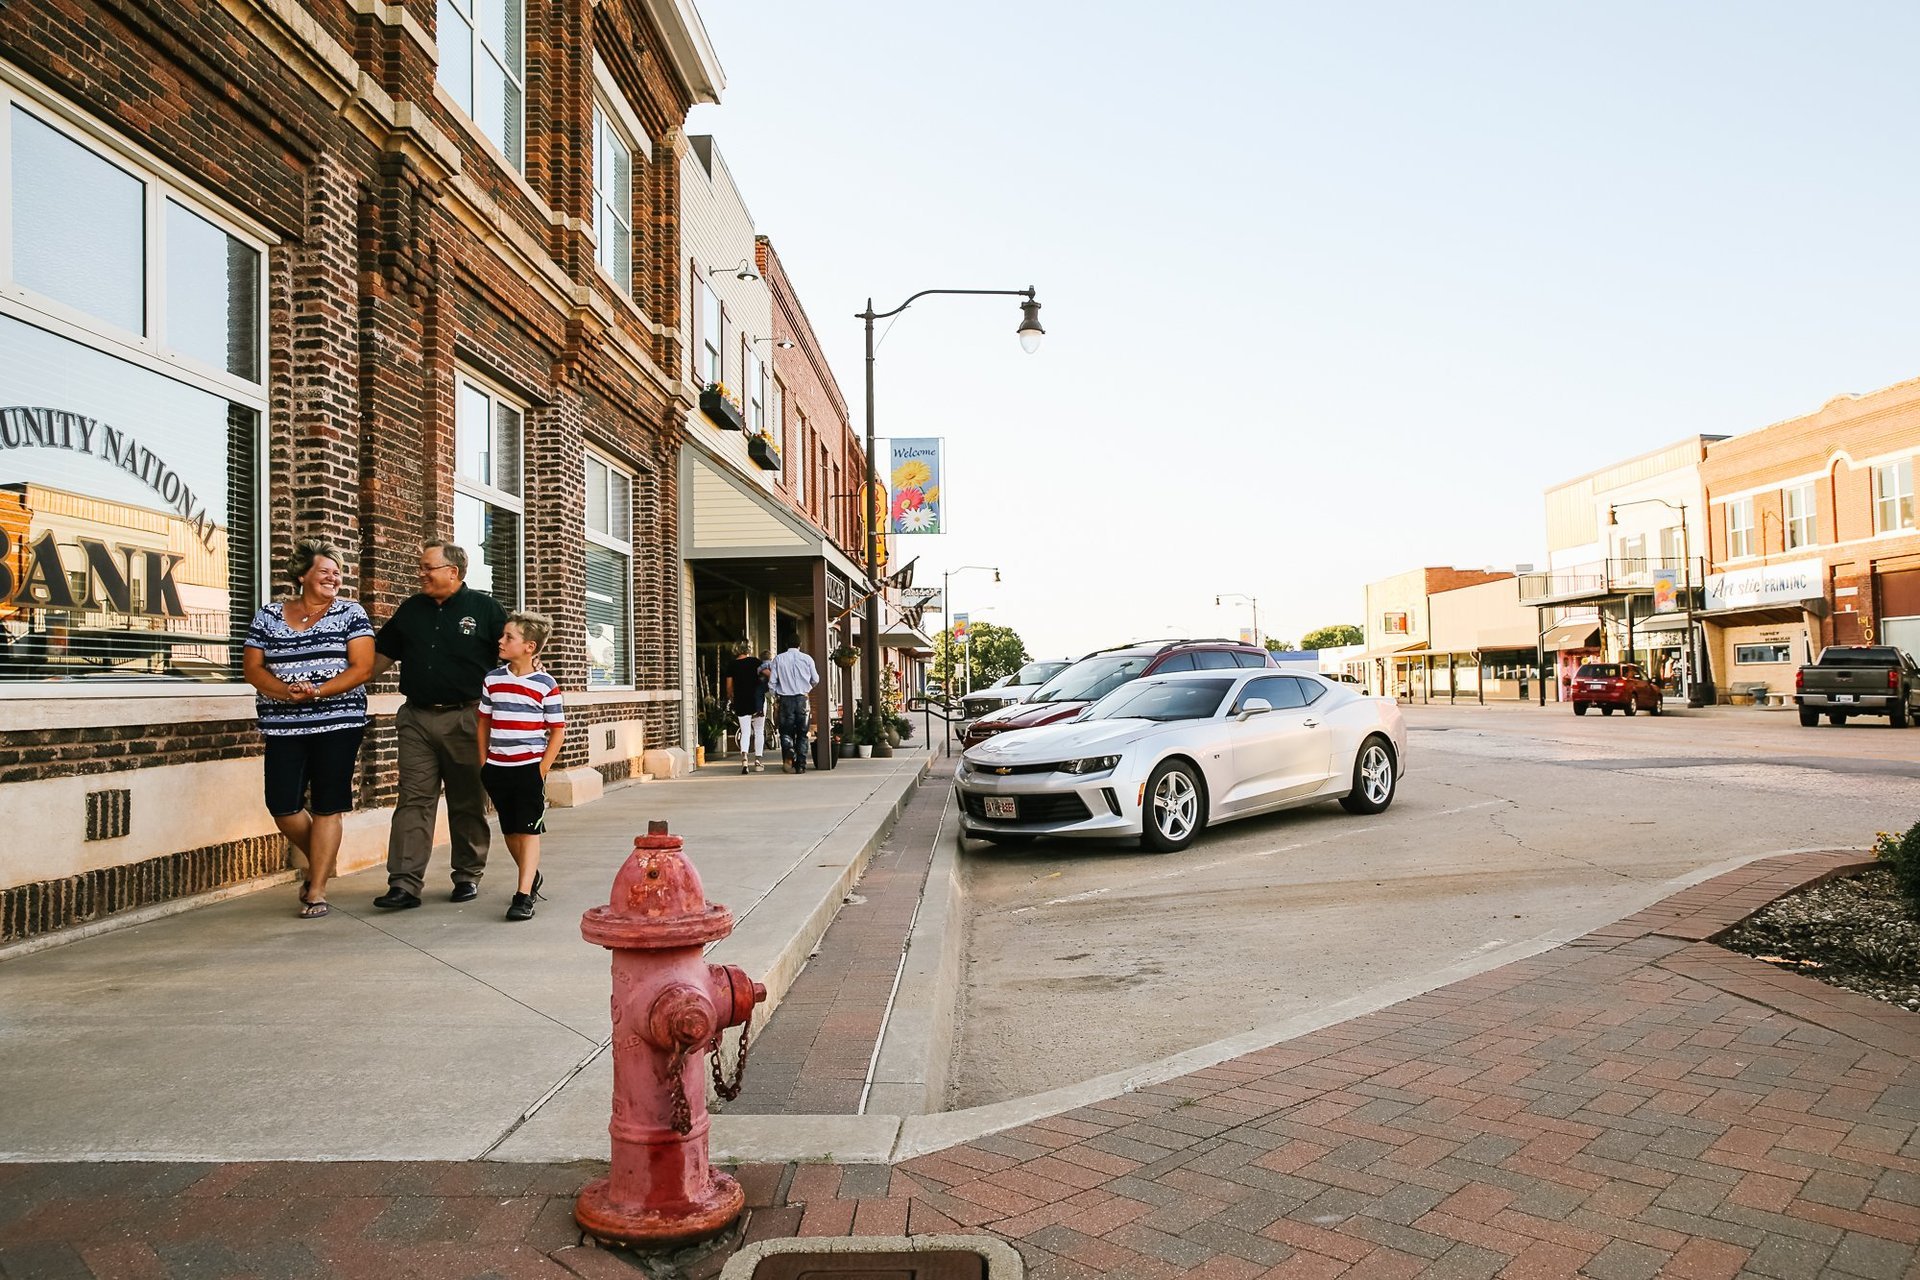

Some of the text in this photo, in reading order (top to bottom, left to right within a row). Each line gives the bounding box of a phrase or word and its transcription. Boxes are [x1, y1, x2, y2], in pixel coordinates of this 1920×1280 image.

[0, 405, 216, 554] UNITY NATIONAL
[893, 446, 936, 458] Welcome
